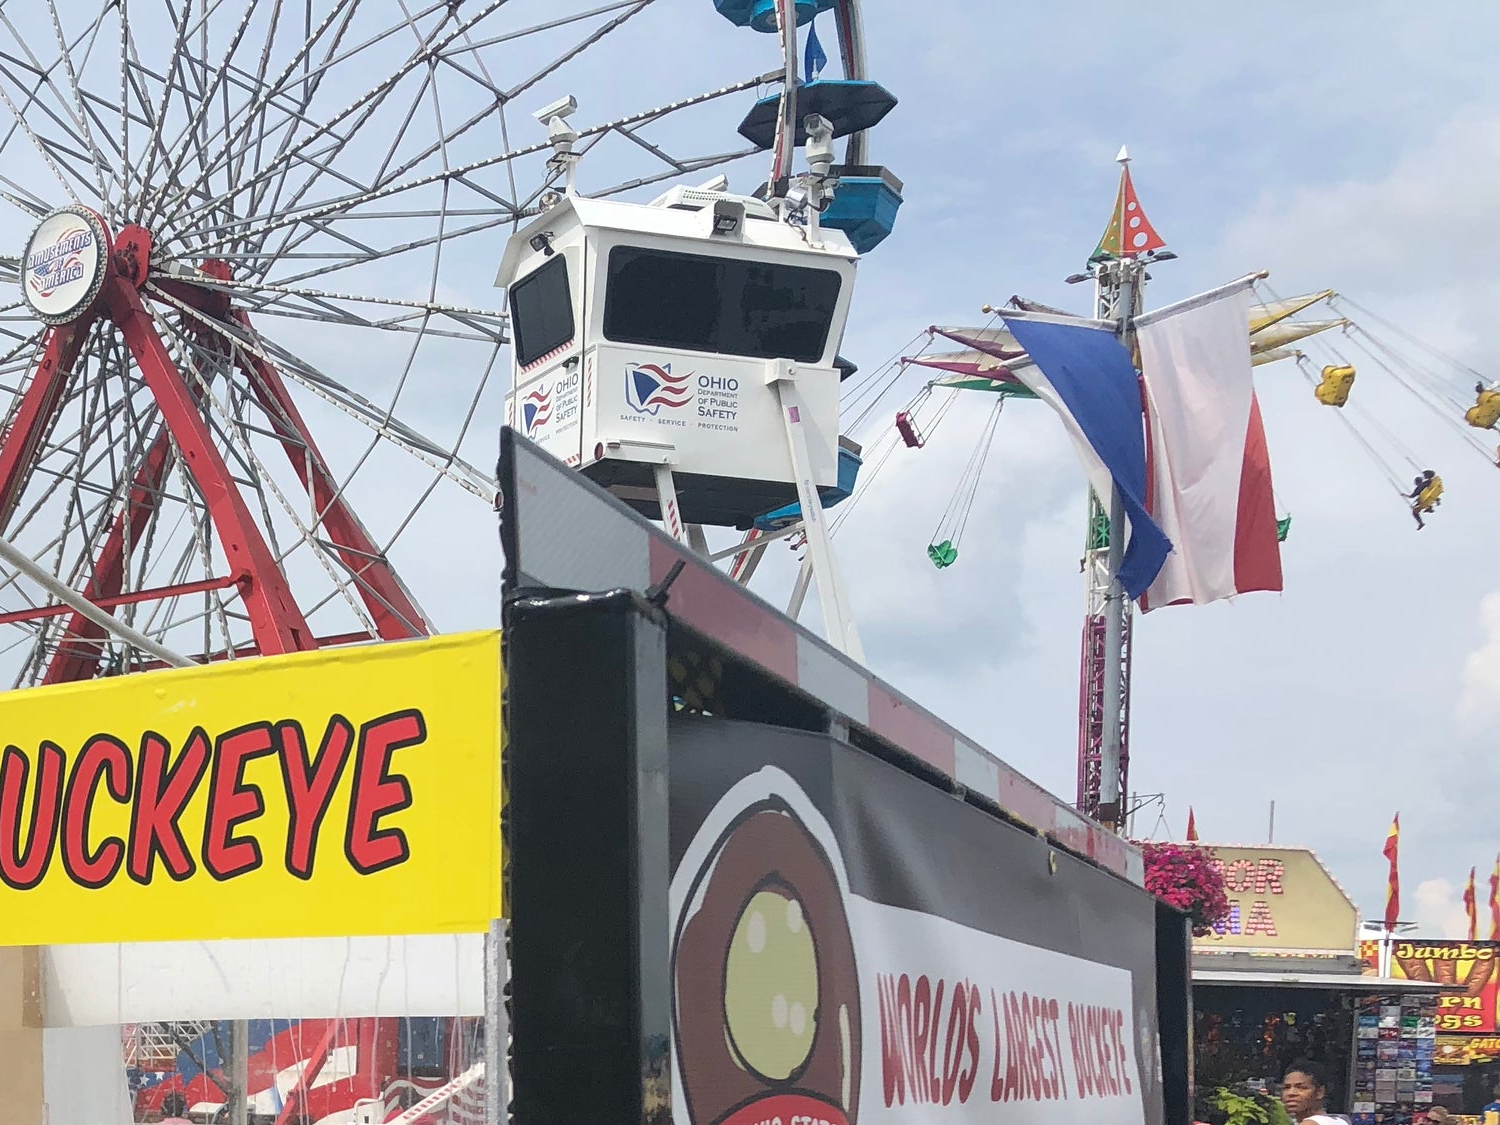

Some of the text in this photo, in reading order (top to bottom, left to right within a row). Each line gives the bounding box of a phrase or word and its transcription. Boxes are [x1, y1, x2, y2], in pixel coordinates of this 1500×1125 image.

[556, 373, 579, 394] OHIO
[698, 375, 739, 391] OHIO
[697, 388, 738, 399] DEPARTMENT
[710, 397, 738, 409] PUBLIC
[556, 405, 578, 423] SAFETY
[697, 406, 737, 420] SAFETY
[620, 414, 738, 433] SAFETY SERVICE PROTECTION
[1396, 943, 1494, 960] Jumbo
[877, 972, 1132, 1108] WORLD'S LARGEST BUCKEYE
